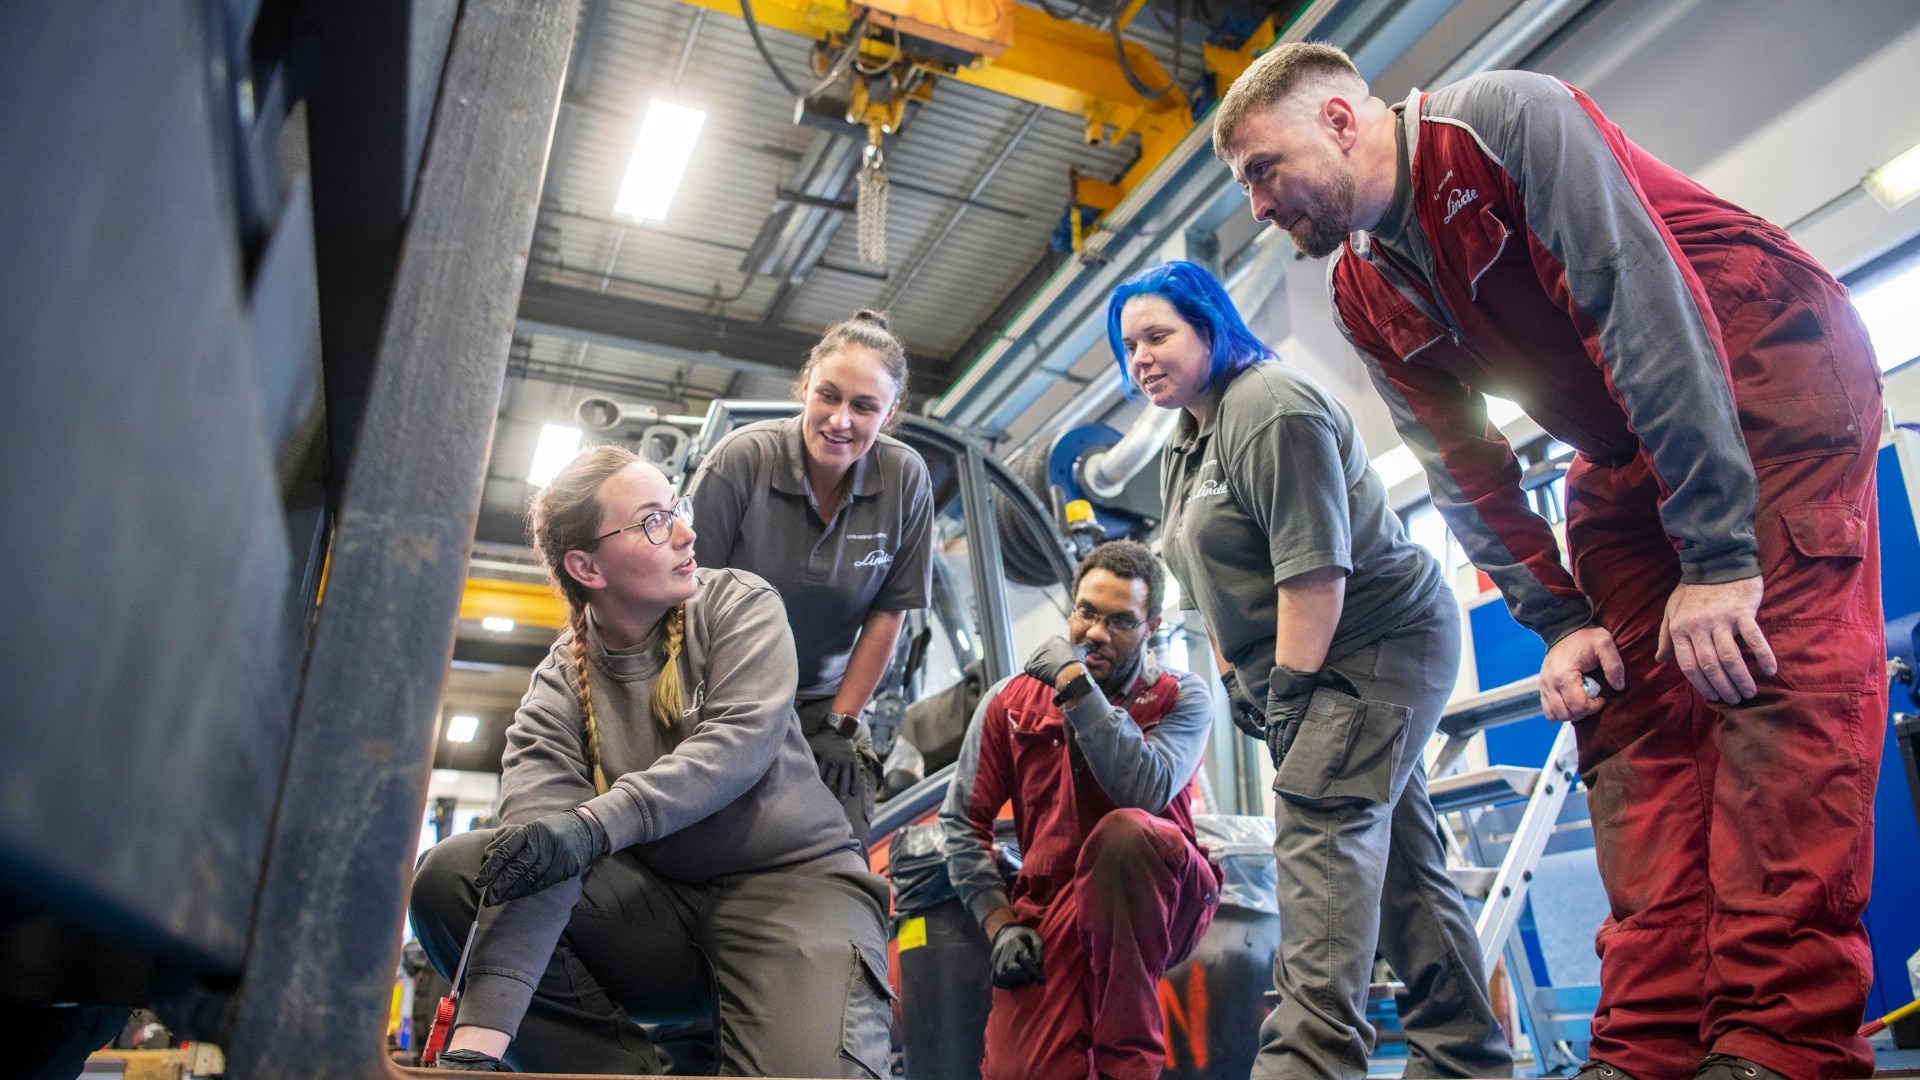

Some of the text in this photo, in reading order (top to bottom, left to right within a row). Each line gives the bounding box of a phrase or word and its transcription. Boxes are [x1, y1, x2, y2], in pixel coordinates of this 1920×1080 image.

[1443, 188, 1479, 225] Linde
[1186, 479, 1228, 504] Linde
[853, 549, 894, 567] Linde
